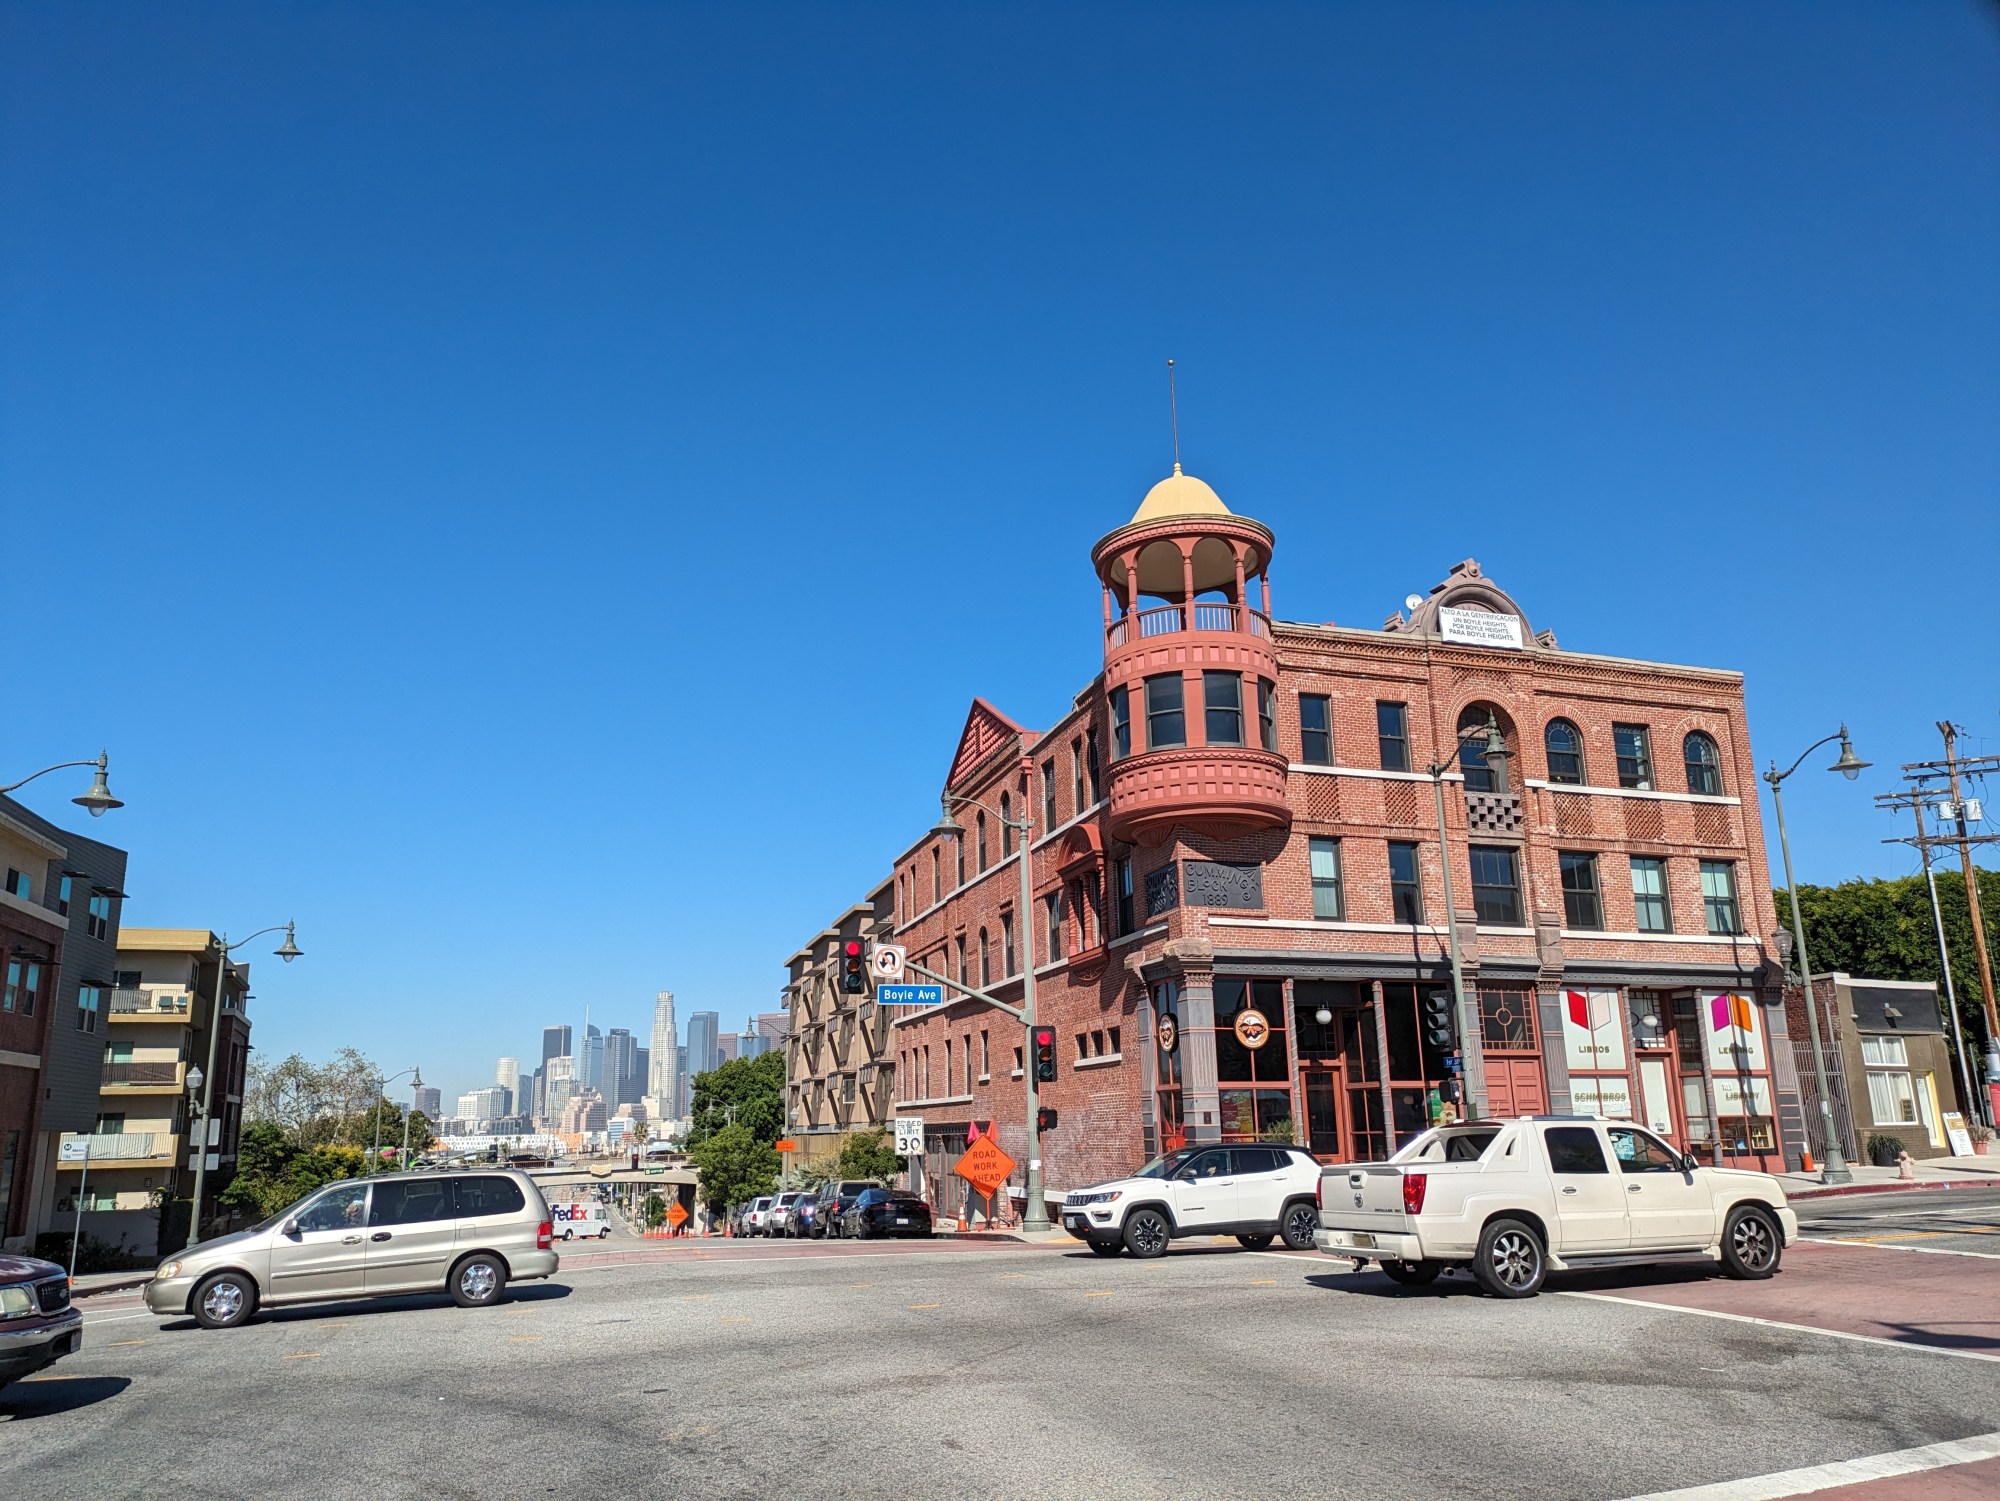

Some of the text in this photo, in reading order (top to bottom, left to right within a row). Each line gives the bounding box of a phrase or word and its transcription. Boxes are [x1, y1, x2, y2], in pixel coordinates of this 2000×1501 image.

[1186, 864, 1260, 901] CUMMINGS
[1186, 880, 1228, 892] BLOCK
[1202, 894, 1228, 906] 1889
[884, 990, 936, 1002] Boyle Ave
[1578, 1046, 1610, 1054] LIBROS
[1718, 1046, 1754, 1054] LENDING
[899, 1138, 920, 1150] 30
[972, 1150, 996, 1160] ROAD
[973, 1162, 998, 1171] WORK
[972, 1174, 1000, 1183] AHEAD
[552, 1204, 588, 1221] FedEx
